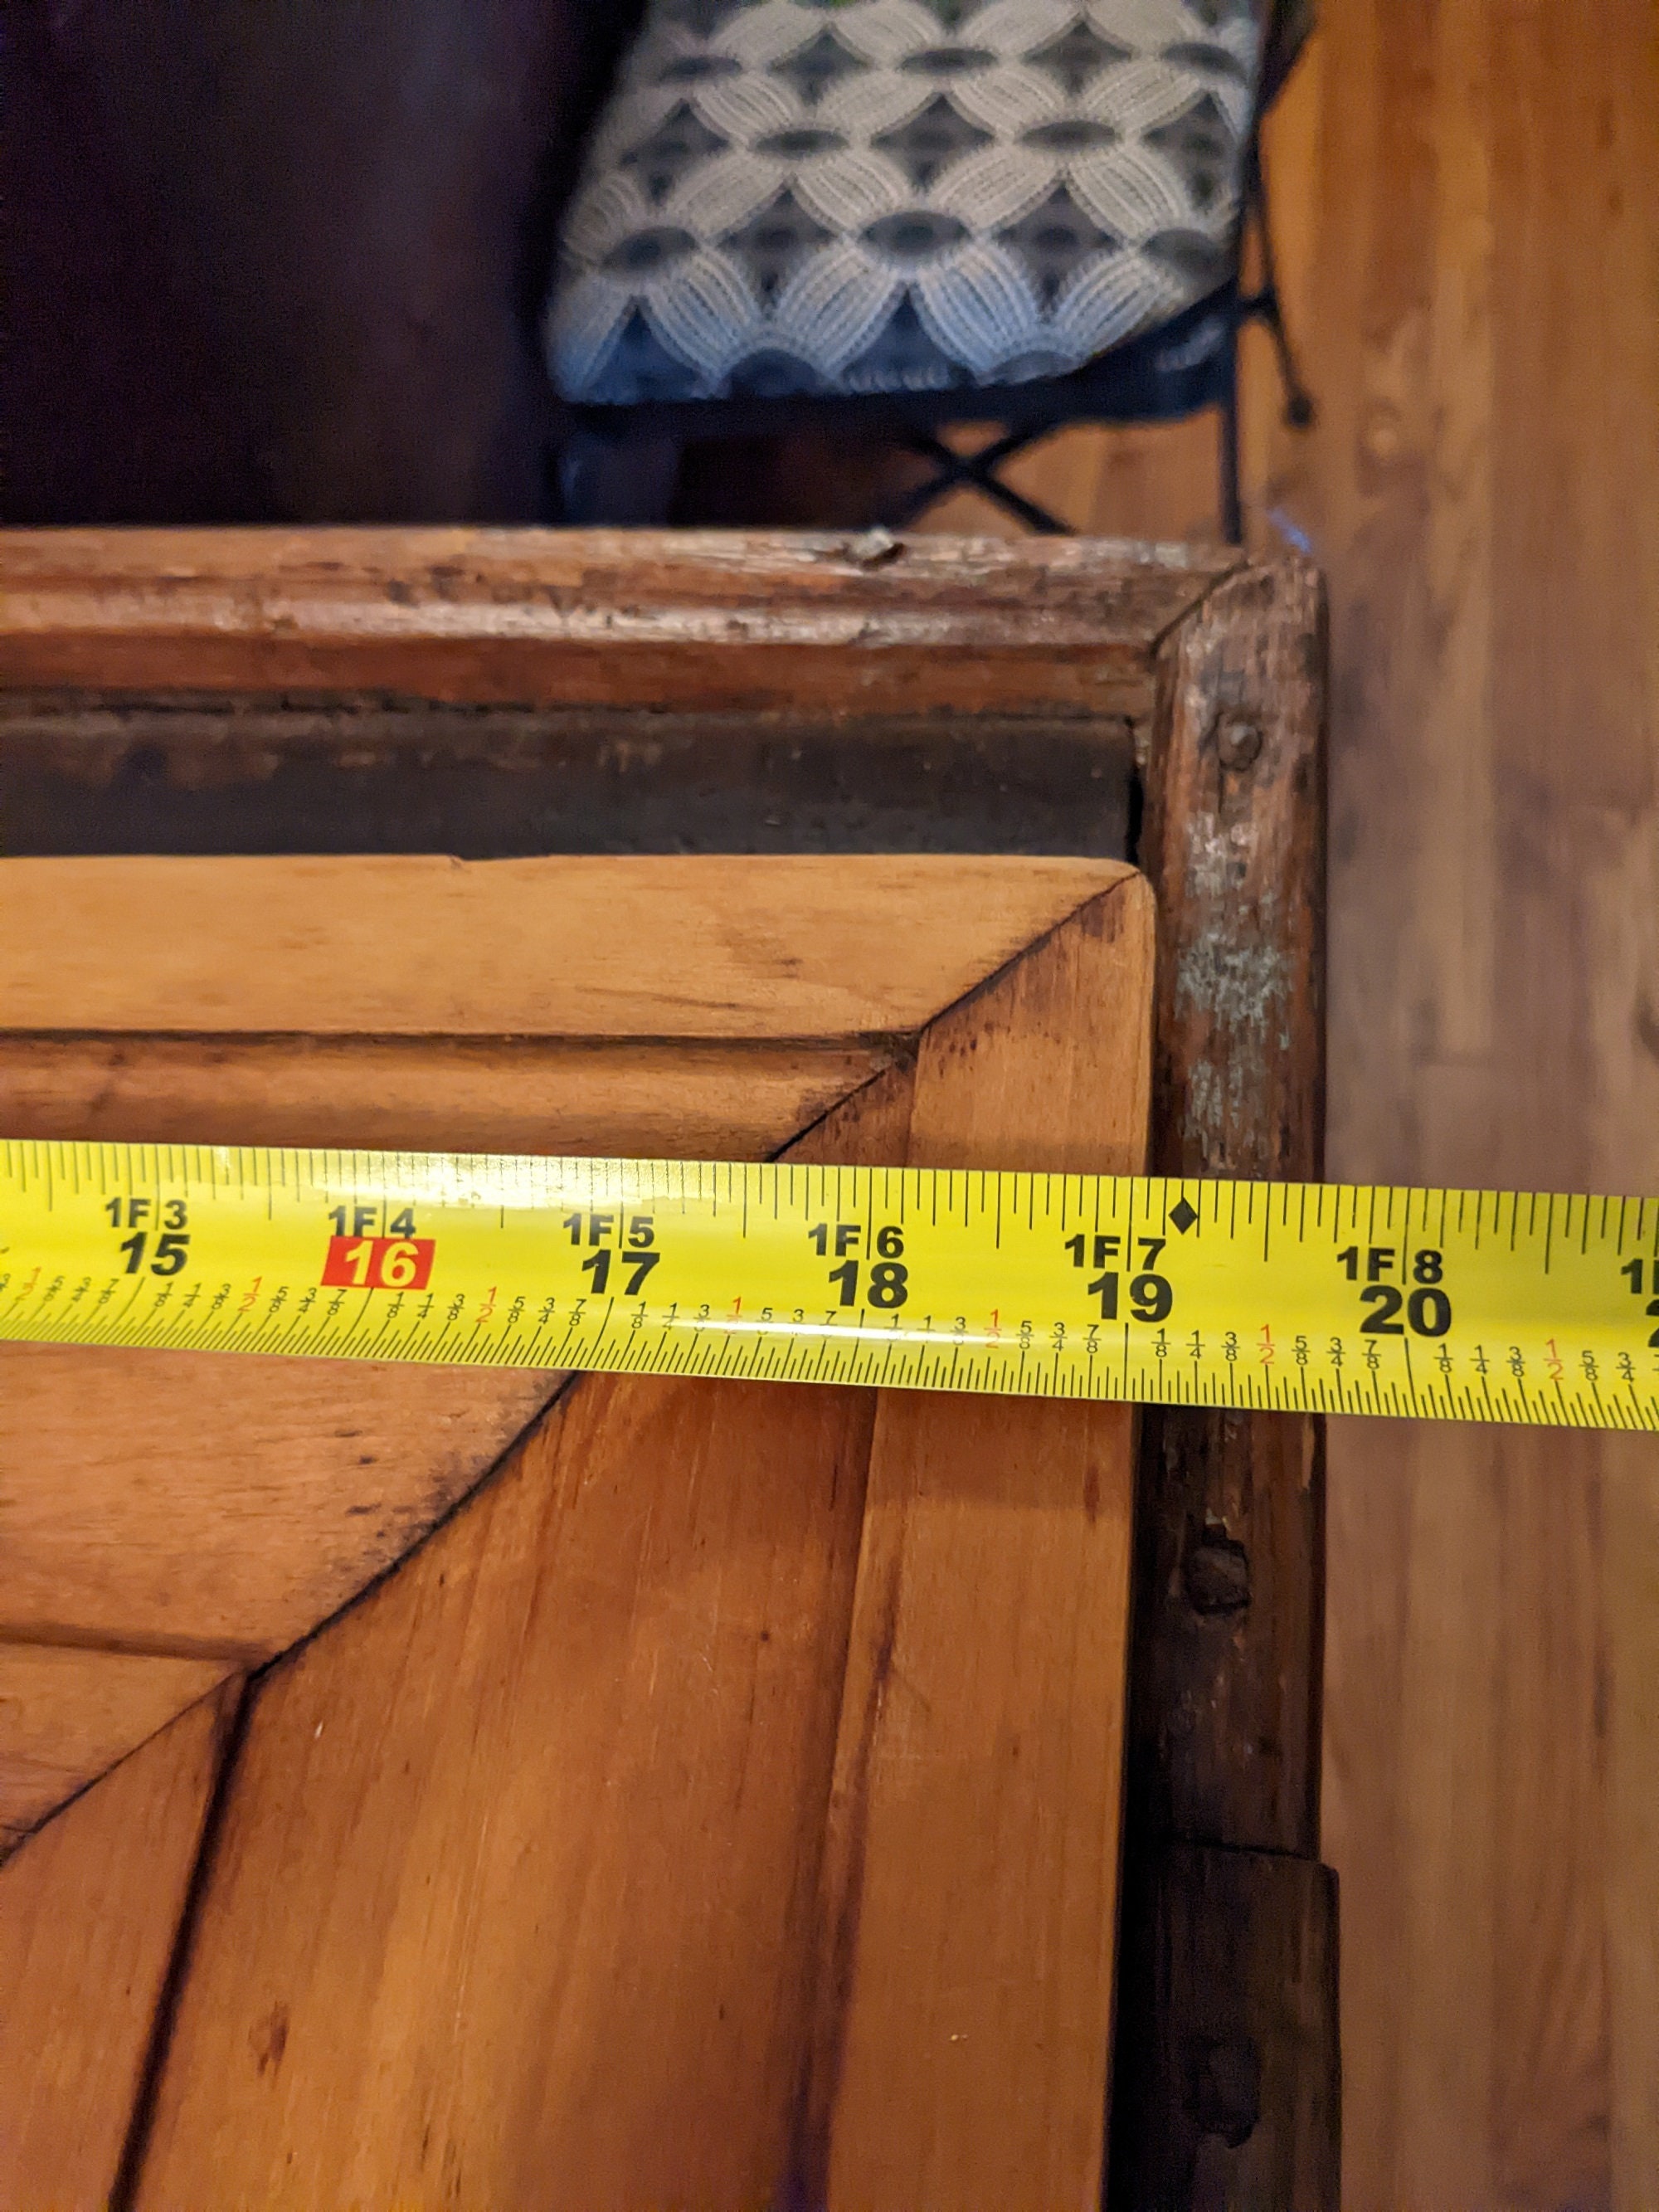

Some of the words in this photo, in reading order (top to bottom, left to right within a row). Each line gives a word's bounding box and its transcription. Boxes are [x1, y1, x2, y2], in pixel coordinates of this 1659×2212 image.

[119, 1231, 191, 1276] 15
[344, 1240, 419, 1287] 16
[581, 1249, 660, 1296] 17
[828, 1259, 908, 1308] 18
[1087, 1271, 1173, 1323] 19
[1360, 1284, 1452, 1337] 20
